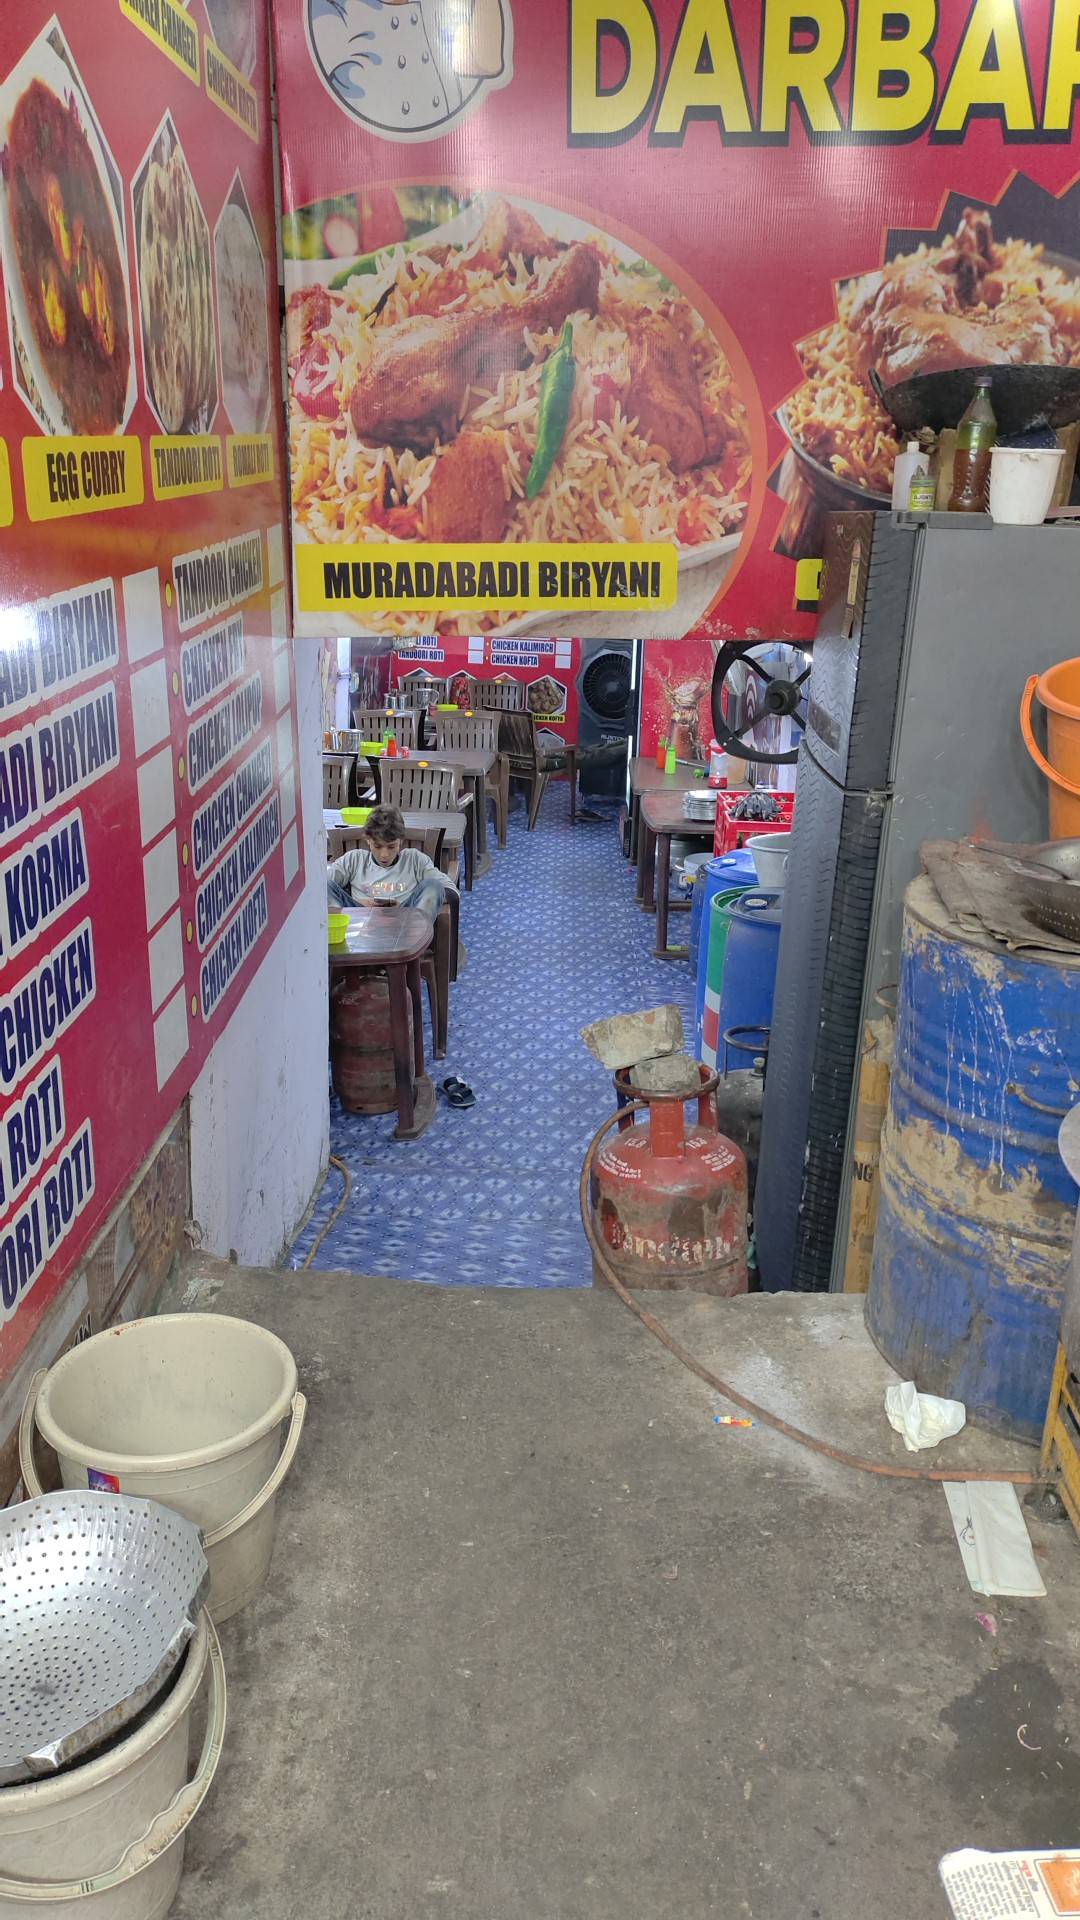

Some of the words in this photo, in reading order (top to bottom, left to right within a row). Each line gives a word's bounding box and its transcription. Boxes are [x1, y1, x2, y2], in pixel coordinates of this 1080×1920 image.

[46, 451, 79, 502] EGG
[81, 451, 126, 498] CURRY
[154, 447, 202, 488] TANDOORI
[202, 446, 221, 482] ROTI
[174, 549, 228, 623] TANDOORI
[228, 536, 262, 598] CHICKEN
[323, 561, 530, 599] MURADABADI
[538, 561, 661, 598] BIRYANI
[38, 588, 117, 688] BIRYANI
[182, 628, 229, 707] CHICKEN
[422, 636, 437, 646] ROTI
[429, 650, 444, 661] ROTI
[491, 653, 518, 665] CHICKEN
[519, 655, 538, 666] KOFTA
[492, 640, 518, 651] CHICKEN
[519, 641, 554, 653] KALIMIRCH
[38, 691, 117, 803] BIRYANI
[188, 704, 232, 787] CHICKEN
[193, 782, 234, 871] CHICKEN
[235, 742, 272, 828] CHANGEZI
[5, 819, 86, 946] KORMA
[197, 865, 239, 945] CHICKEN
[240, 800, 279, 888] KALIMIRCH
[201, 925, 242, 1016] CHICKEN
[243, 886, 268, 954] KOFTA
[0, 928, 93, 1084] CHICKEN
[7, 1068, 62, 1190] ROTI
[44, 1129, 92, 1249] ROTI
